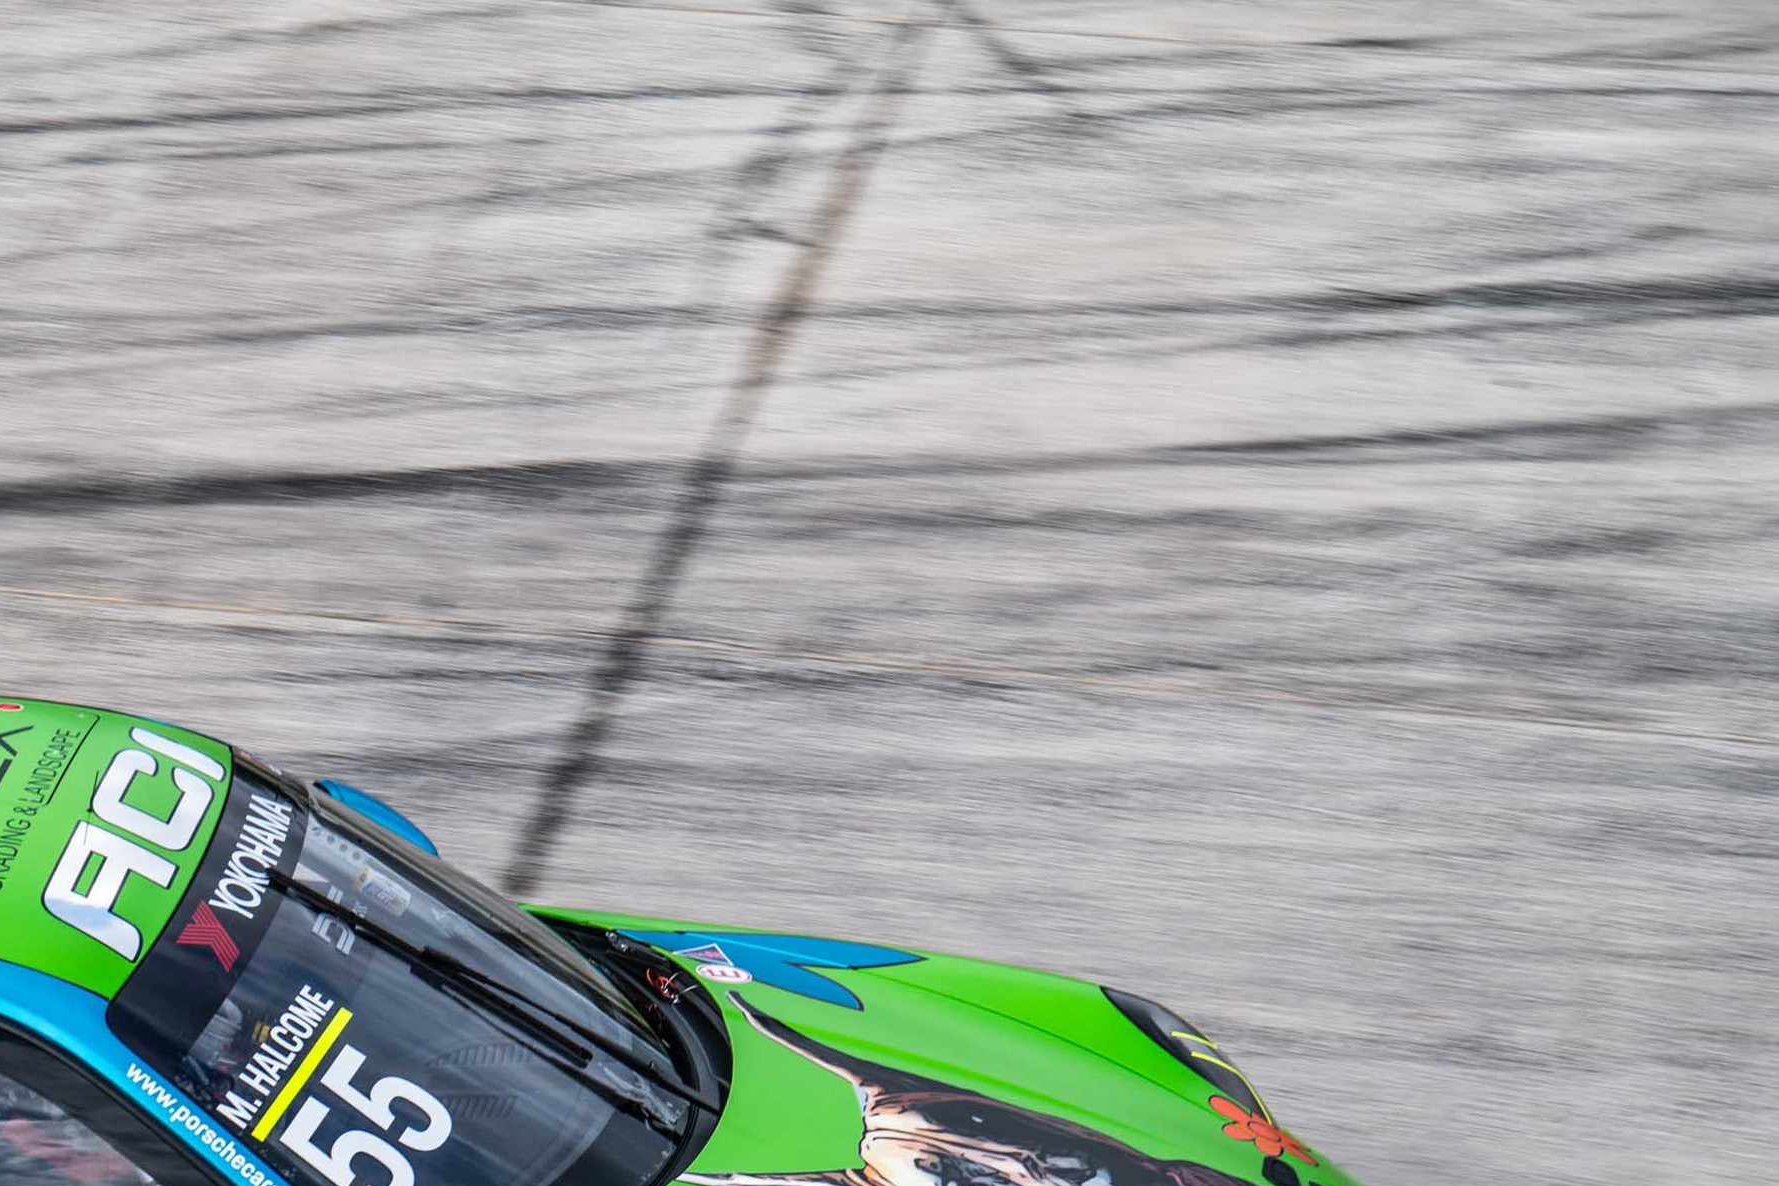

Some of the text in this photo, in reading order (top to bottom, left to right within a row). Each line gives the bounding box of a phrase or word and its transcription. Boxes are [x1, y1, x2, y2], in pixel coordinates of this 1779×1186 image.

[13, 802, 39, 819] &
[19, 726, 81, 806] LANDSCAPE
[41, 725, 226, 963] ACI
[208, 794, 294, 919] YOKOHAMA
[239, 984, 335, 1097] HALCOME
[216, 1090, 263, 1129] M.
